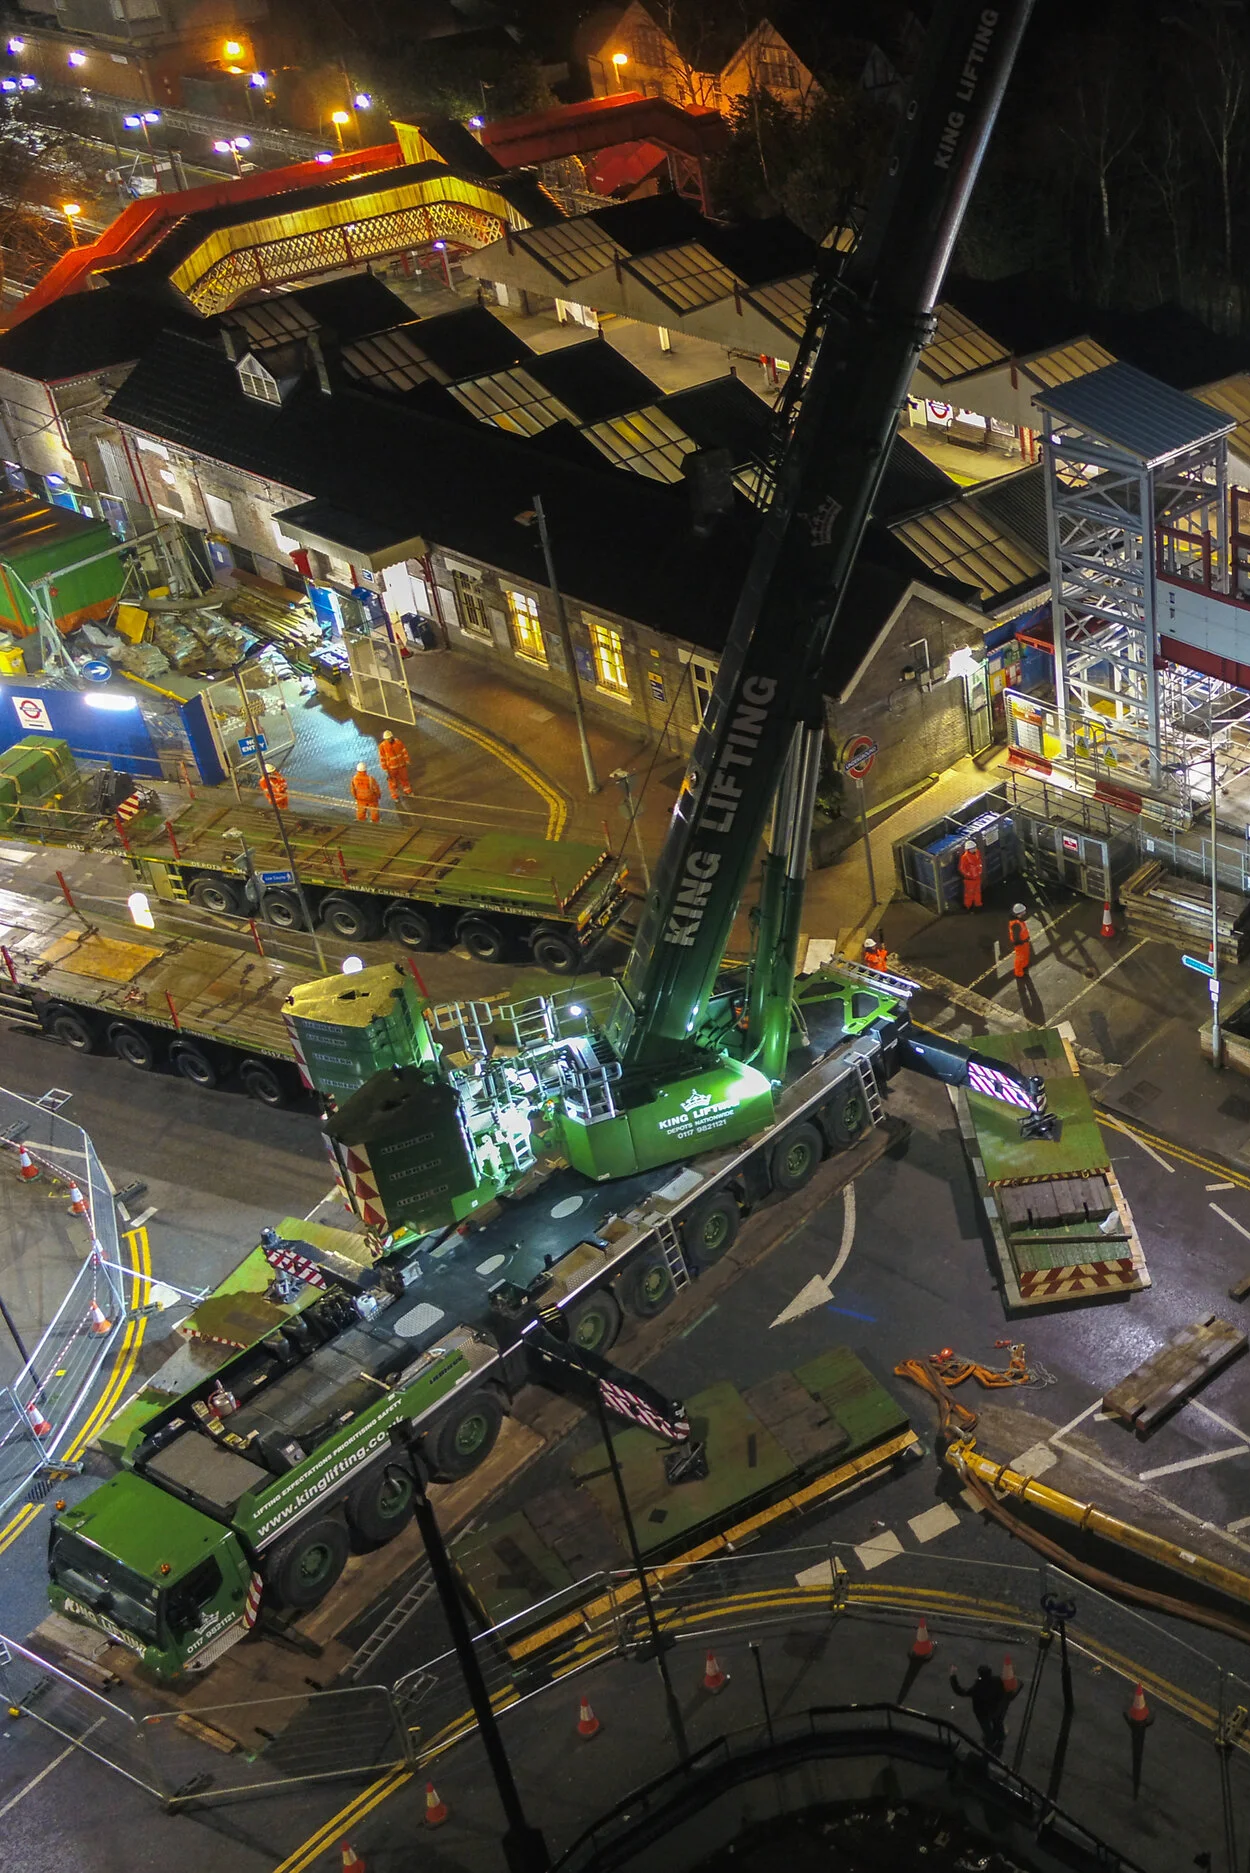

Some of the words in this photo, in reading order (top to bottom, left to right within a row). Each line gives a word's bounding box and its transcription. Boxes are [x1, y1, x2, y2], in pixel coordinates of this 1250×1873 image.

[934, 111, 966, 169] KING
[956, 8, 999, 102] LIFTING
[664, 850, 721, 946] KING
[700, 675, 778, 833] LIFTING
[658, 1113, 690, 1130] KING
[666, 1122, 693, 1135] DEPOTS
[694, 1109, 735, 1126] NATIONWIDE
[677, 1129, 694, 1139] 0117
[696, 1119, 727, 1134] 9821121
[253, 1494, 282, 1519] LIFTING
[281, 1453, 333, 1497] EXPECTATIONS
[333, 1418, 377, 1456] PRIORITISING
[377, 1398, 402, 1421] SAFETY
[187, 1637, 204, 1654] 0117
[205, 1611, 236, 1638] 9821121
